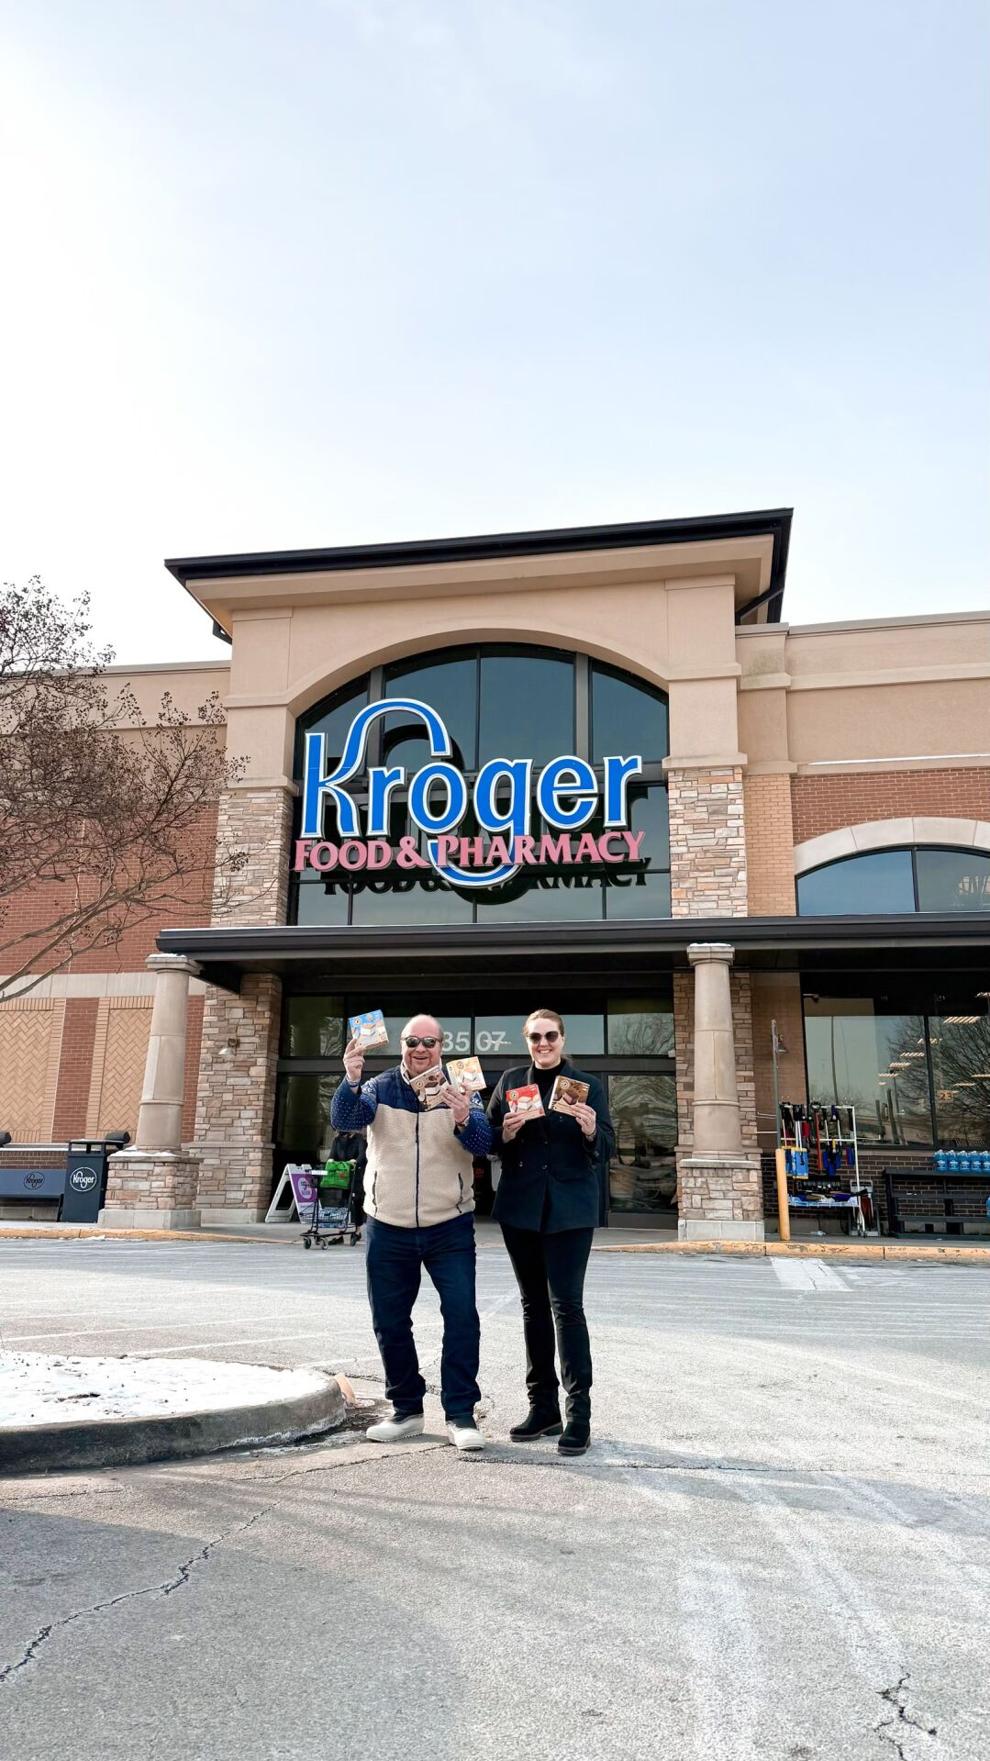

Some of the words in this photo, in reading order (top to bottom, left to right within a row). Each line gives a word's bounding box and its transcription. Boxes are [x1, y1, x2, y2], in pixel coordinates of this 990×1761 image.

[301, 698, 642, 886] Kroger
[294, 838, 392, 872] FOOD
[395, 835, 435, 868] &
[437, 830, 646, 867] PHARMACY
[26, 1173, 43, 1188] Kroger
[72, 1170, 95, 1189] Kroger
